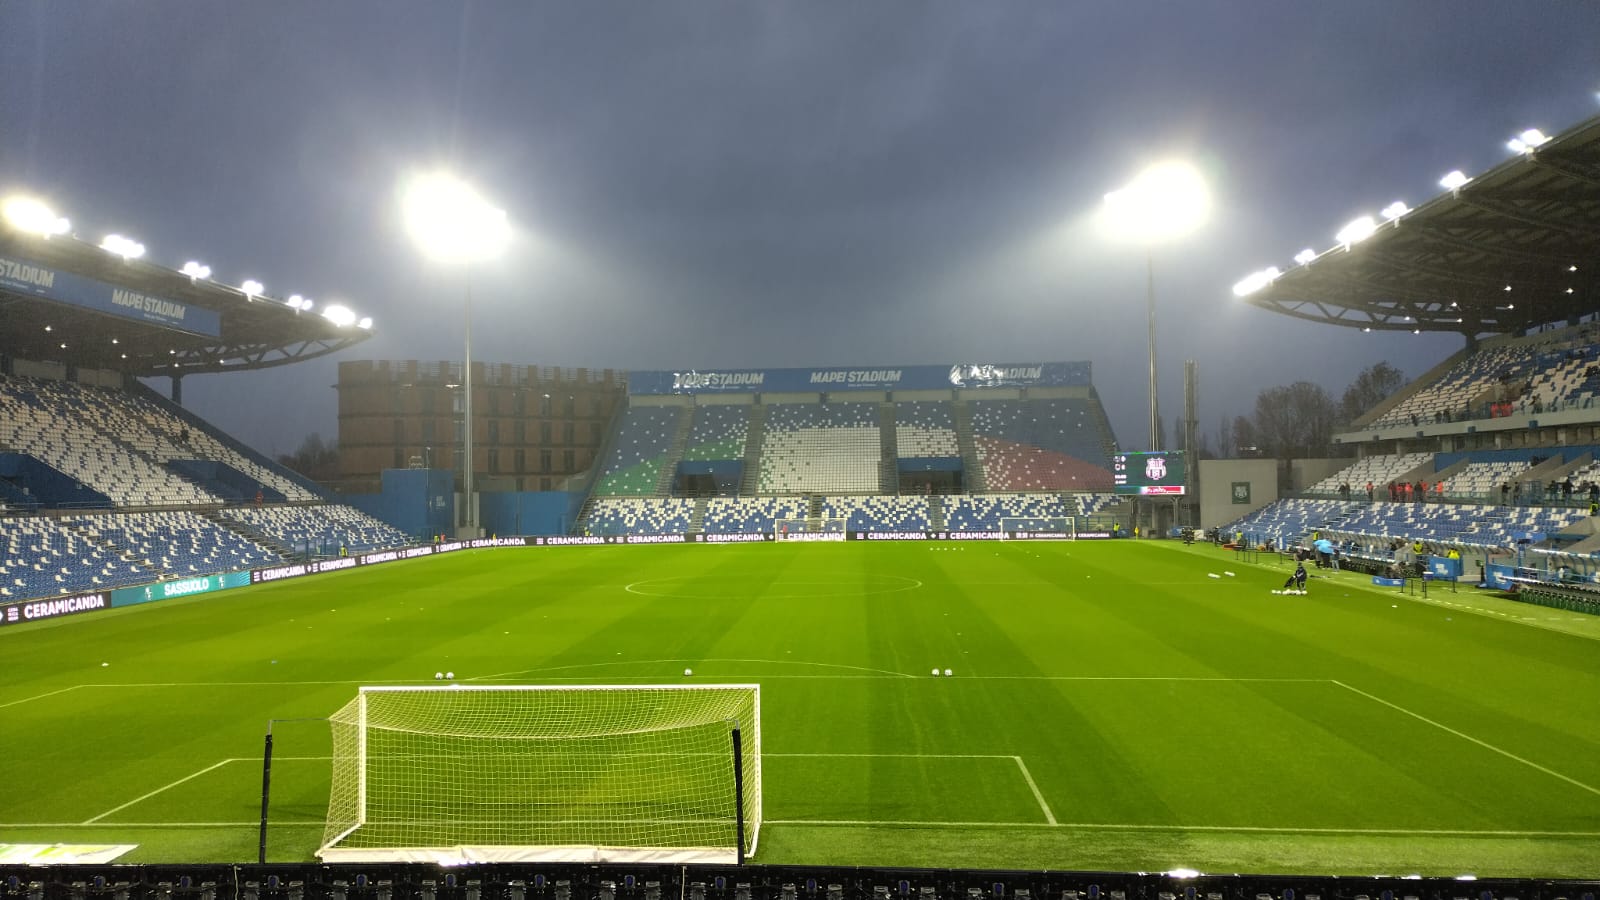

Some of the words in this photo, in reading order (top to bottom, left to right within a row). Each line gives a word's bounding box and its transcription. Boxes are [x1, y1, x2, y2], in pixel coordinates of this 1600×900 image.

[112, 289, 145, 310] MAPEI
[144, 297, 186, 320] STADIUM
[711, 373, 764, 385] STADIUM
[810, 371, 847, 384] MAPEI
[847, 370, 902, 383] STADIUM
[547, 537, 605, 545] CERAMICANDA
[706, 534, 765, 542] CERAMICANDA
[868, 532, 927, 540] CERAMICANDA
[262, 565, 306, 581] CERAMICANDA
[164, 578, 210, 596] SASSUOLO
[24, 595, 105, 619] CERAMICANDA
